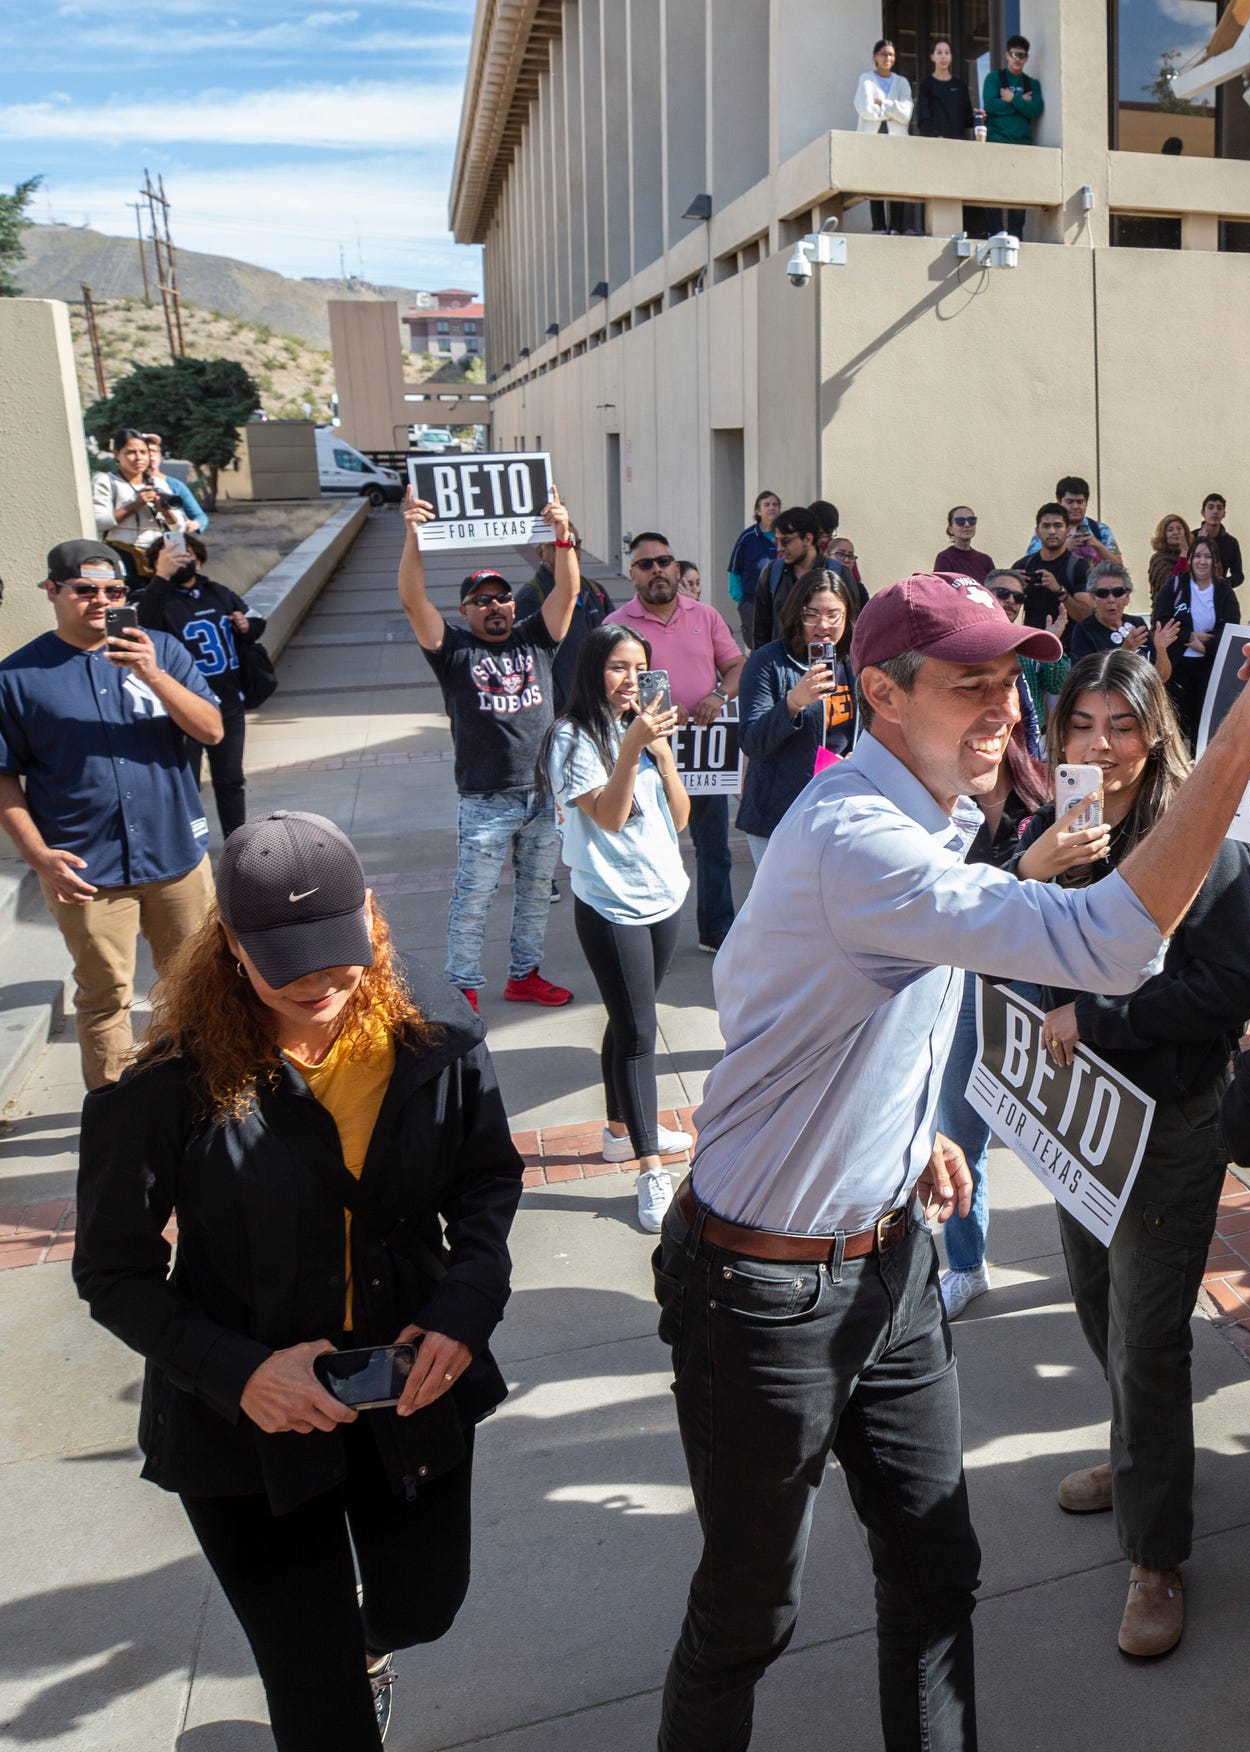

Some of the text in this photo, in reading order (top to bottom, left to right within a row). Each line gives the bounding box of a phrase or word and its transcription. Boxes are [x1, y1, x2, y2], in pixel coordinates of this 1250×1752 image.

[433, 462, 534, 519] BETO
[450, 520, 527, 539] FOR TEXAS
[477, 684, 543, 713] LOBOS
[671, 725, 728, 769] ETO
[1001, 1002, 1121, 1167] BETO
[996, 1093, 1027, 1137] FOR
[1032, 1128, 1083, 1194] TEXAS
